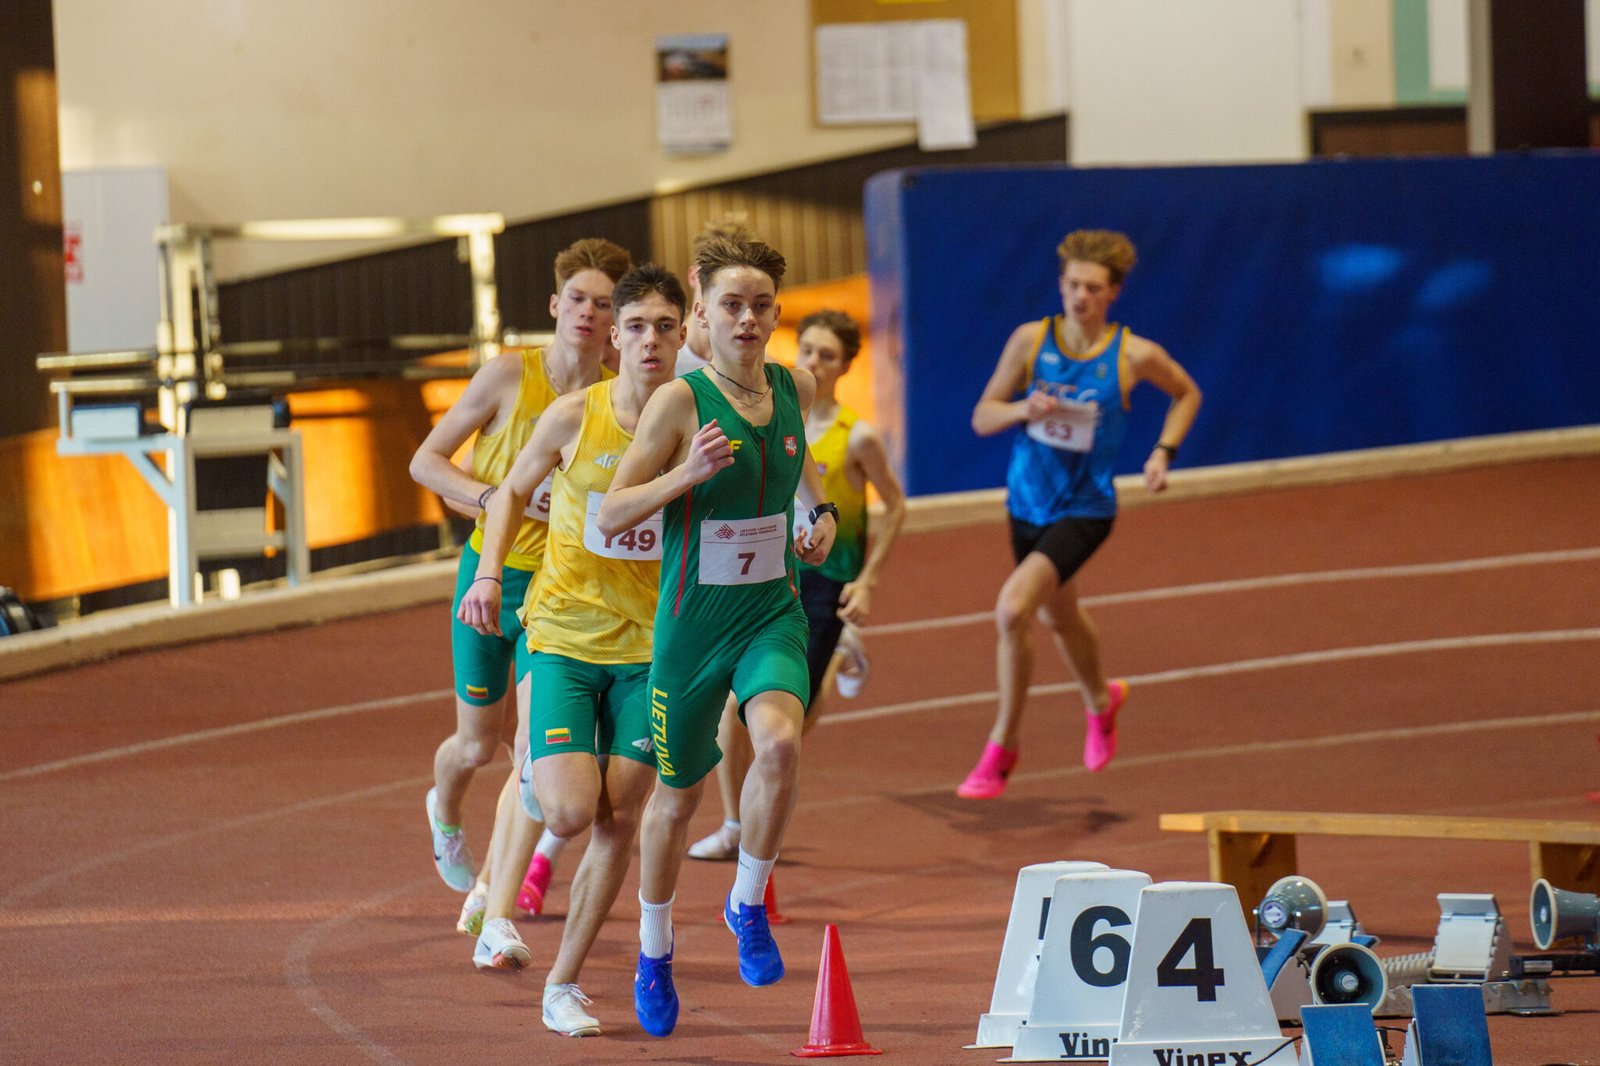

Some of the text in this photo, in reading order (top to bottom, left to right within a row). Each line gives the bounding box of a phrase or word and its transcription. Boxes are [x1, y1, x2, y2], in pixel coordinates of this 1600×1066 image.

[738, 552, 756, 576] 7
[652, 686, 676, 776] LIETUVA
[1069, 905, 1132, 987] 6
[1156, 917, 1226, 1002] 4
